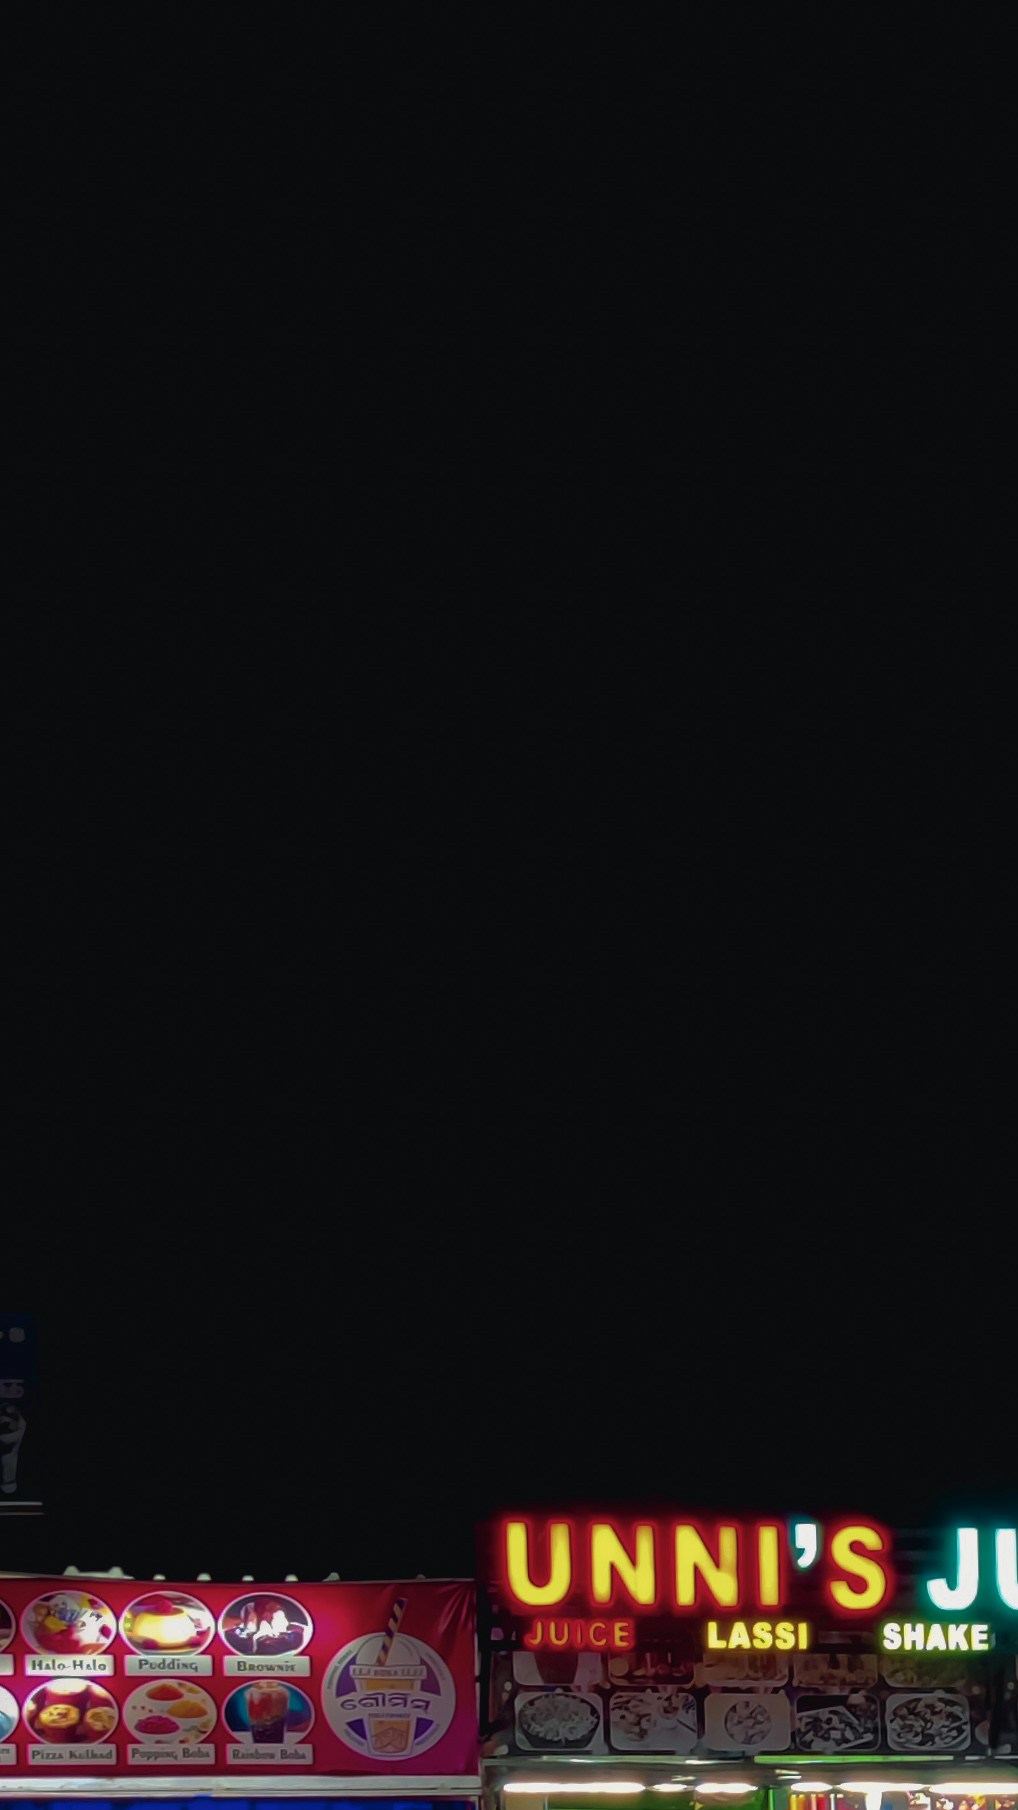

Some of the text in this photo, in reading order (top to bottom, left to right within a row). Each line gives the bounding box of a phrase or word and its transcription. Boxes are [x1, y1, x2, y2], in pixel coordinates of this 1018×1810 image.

[506, 1521, 887, 1610] UNNI'S
[529, 1620, 630, 1648] JUICE
[708, 1621, 808, 1650] LASSI
[883, 1622, 989, 1652] SHAKE
[138, 1658, 199, 1673] Pudding
